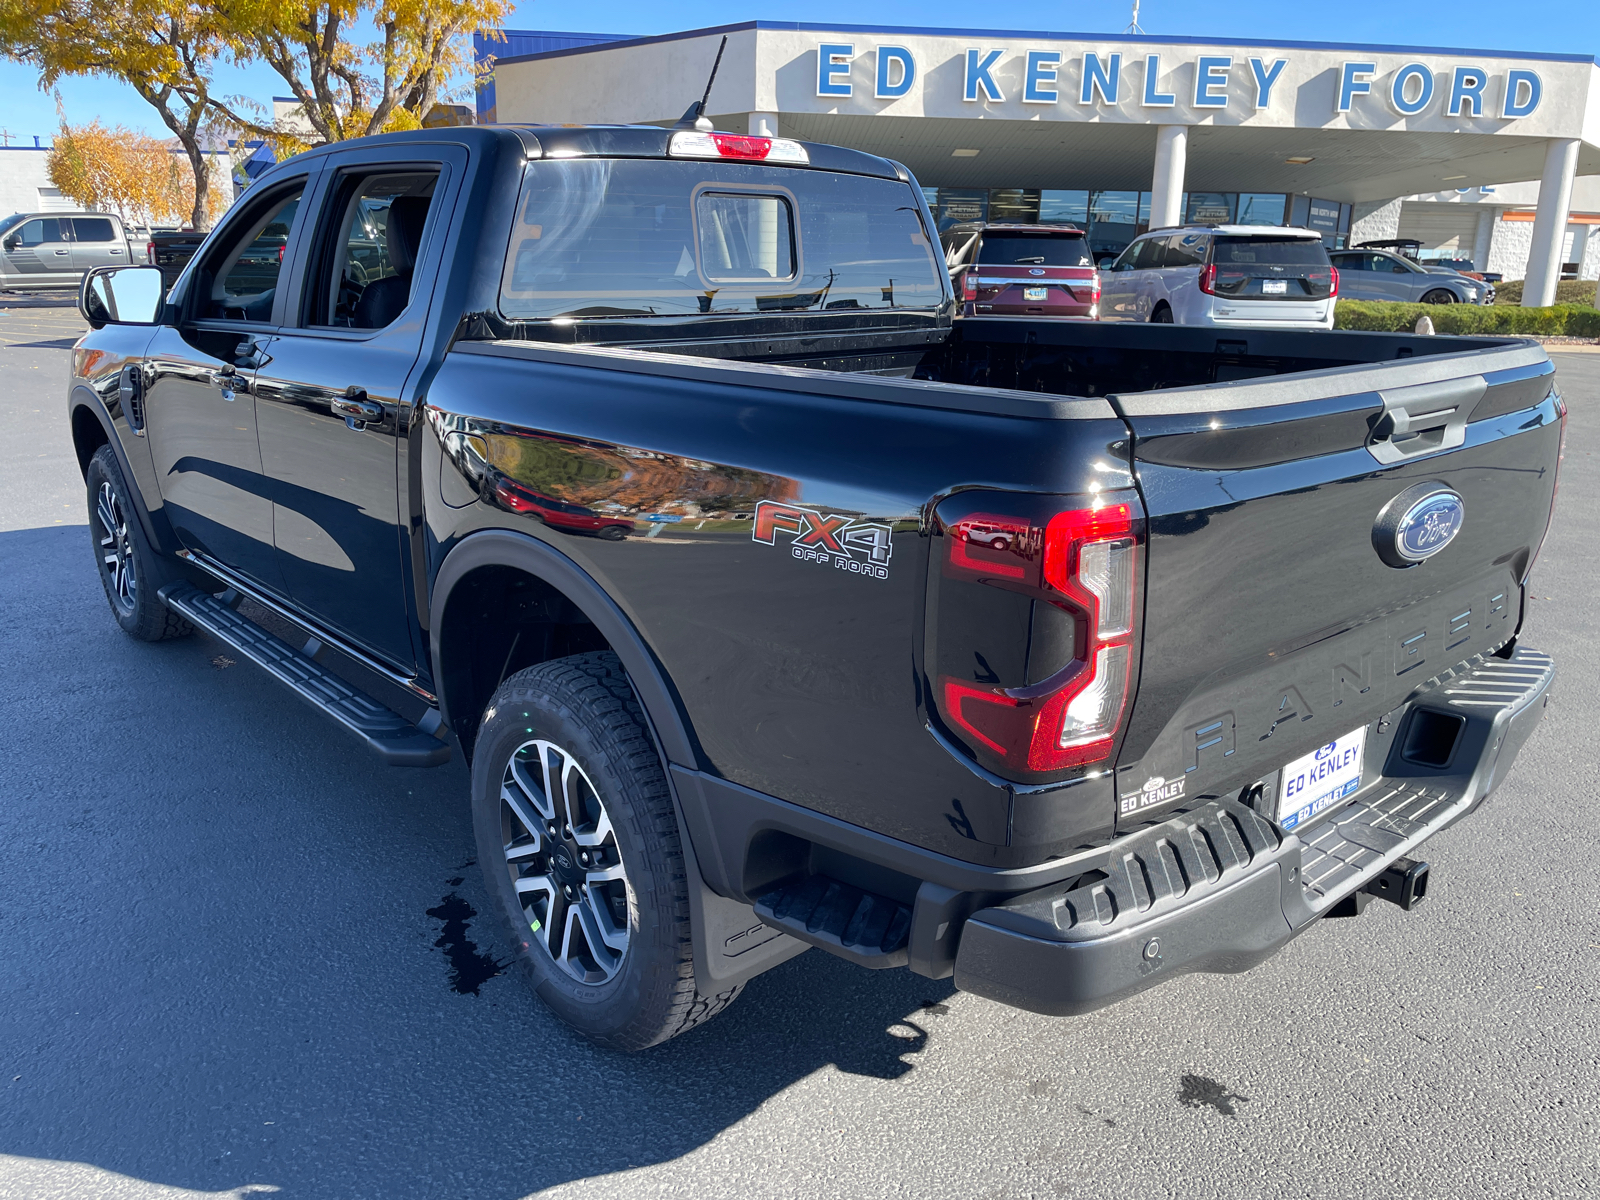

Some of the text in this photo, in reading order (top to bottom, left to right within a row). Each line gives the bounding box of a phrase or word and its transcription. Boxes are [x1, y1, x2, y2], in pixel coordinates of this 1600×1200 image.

[816, 42, 1543, 120] ED KENLEY FORD
[752, 500, 893, 566] FX4
[1418, 508, 1454, 546] Ford
[792, 547, 889, 579] OFF ROAD
[1182, 585, 1508, 773] RANGER
[1287, 774, 1305, 798] ED
[1309, 744, 1359, 786] KENLEY
[1121, 780, 1185, 813] ED KENLEY
[1298, 805, 1311, 822] ED
[1312, 784, 1345, 814] KENLEY
